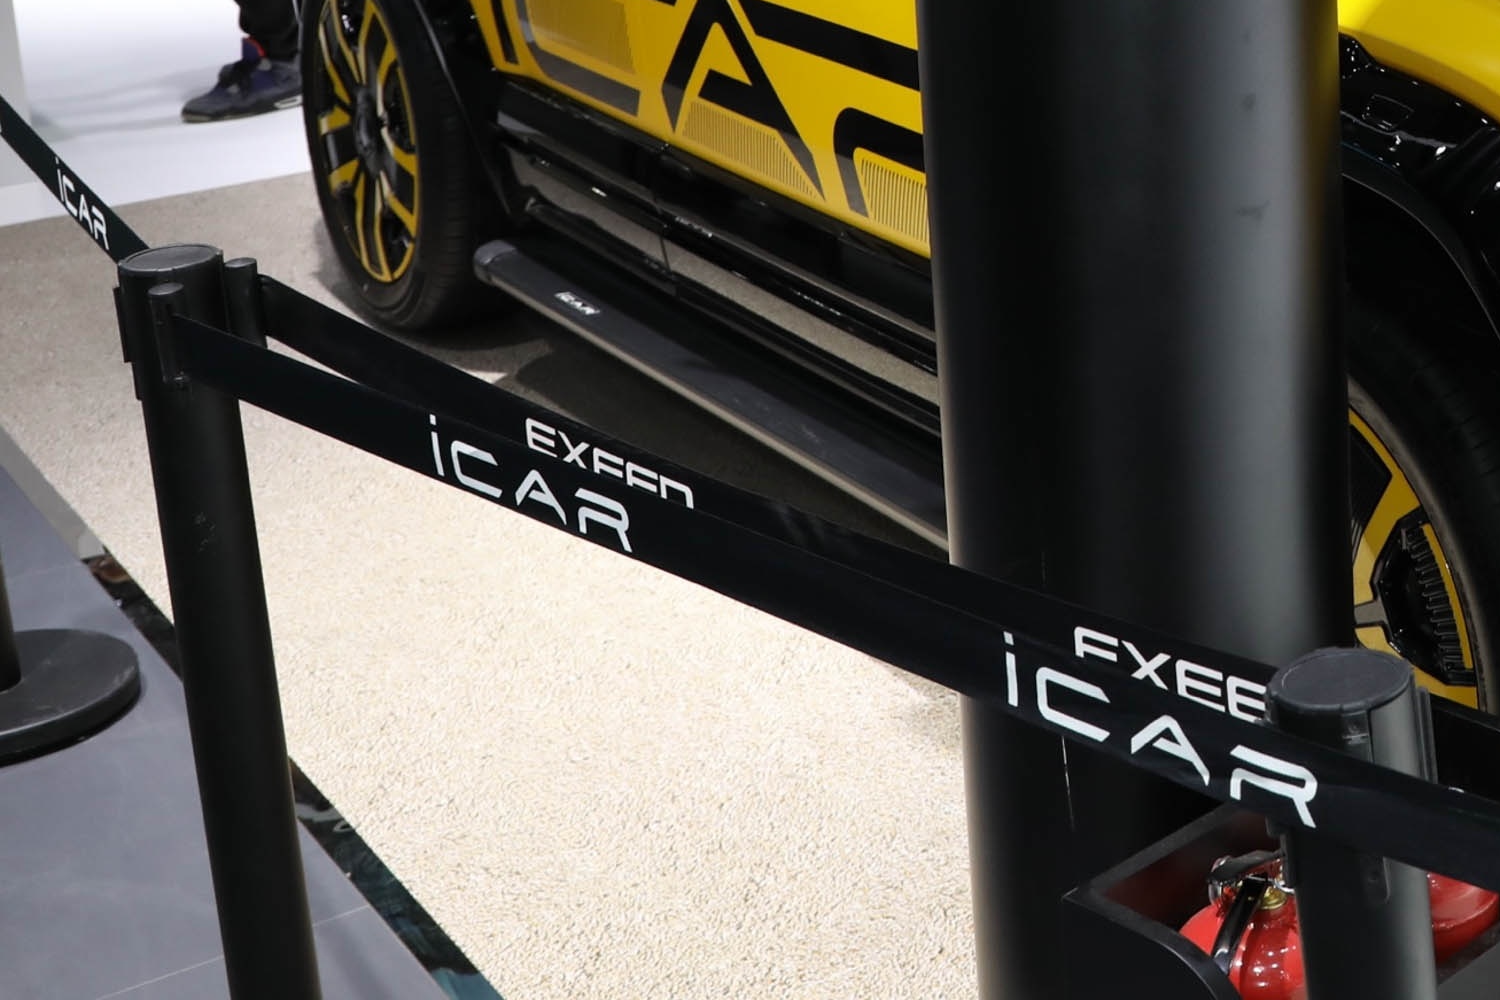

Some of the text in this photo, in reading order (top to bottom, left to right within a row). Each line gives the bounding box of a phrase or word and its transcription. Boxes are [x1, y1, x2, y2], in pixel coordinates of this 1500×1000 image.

[55, 156, 110, 251] iCAR
[428, 413, 634, 553] iCAR
[1003, 630, 1319, 829] iCAR
